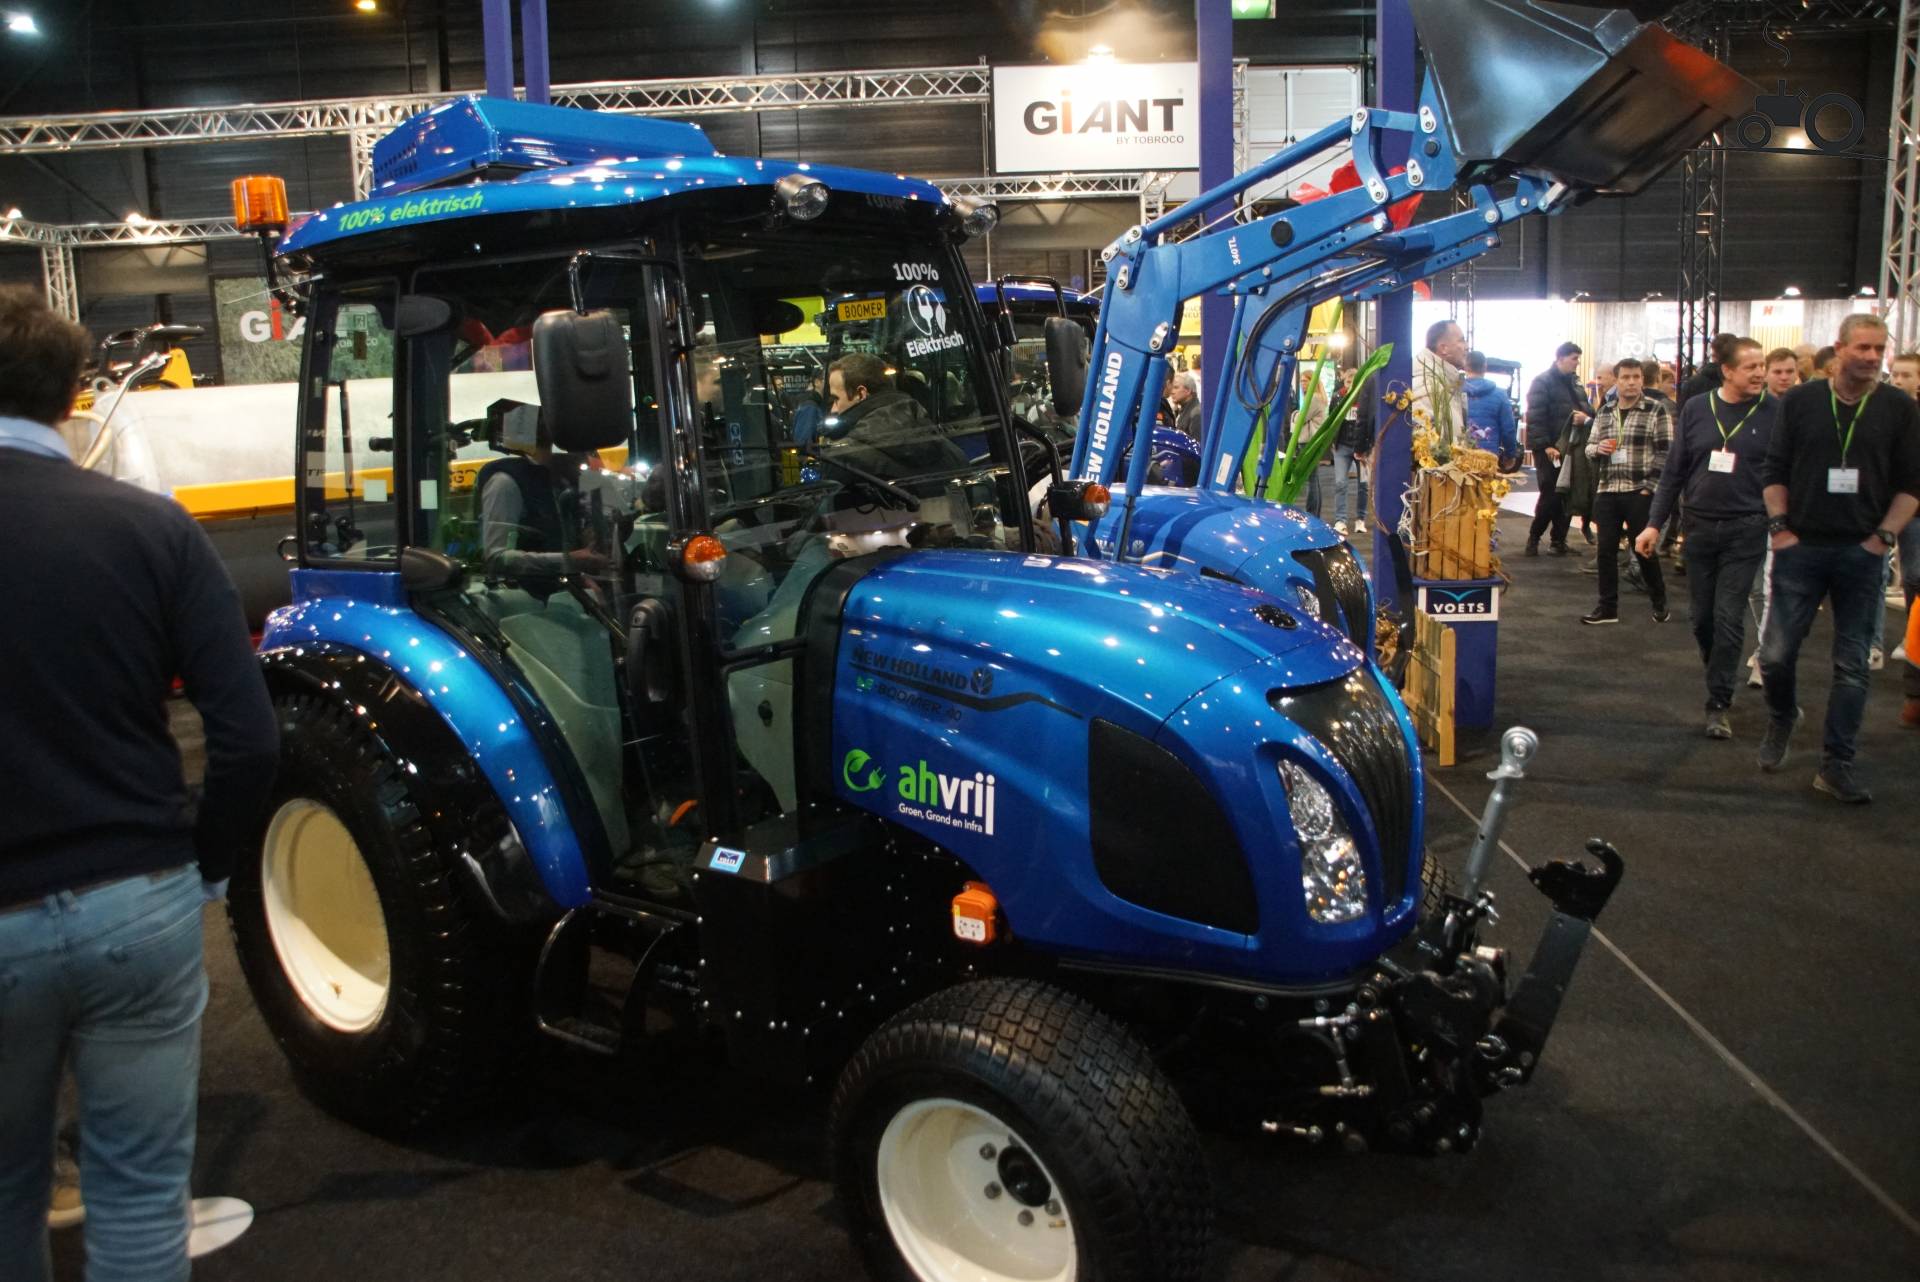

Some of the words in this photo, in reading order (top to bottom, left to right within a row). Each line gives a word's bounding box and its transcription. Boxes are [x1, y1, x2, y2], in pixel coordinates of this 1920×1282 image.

[1116, 136, 1131, 145] BY
[1134, 135, 1184, 144] TOBROCO
[338, 206, 387, 232] 100%
[390, 190, 484, 222] elektrisch
[1227, 235, 1241, 266] 340TL
[892, 263, 940, 281] 100%
[844, 302, 883, 319] BOOMER
[906, 330, 965, 358] Elektrisch
[1092, 352, 1123, 451] HOLLAND
[1433, 603, 1485, 614] VOETS
[853, 646, 888, 668] NEW
[890, 658, 968, 690] HOLLAND
[898, 759, 995, 835] ahvrij
[898, 803, 925, 819] Groen,
[926, 809, 951, 825] Grond
[952, 818, 963, 829] en
[964, 819, 983, 833] Infra
